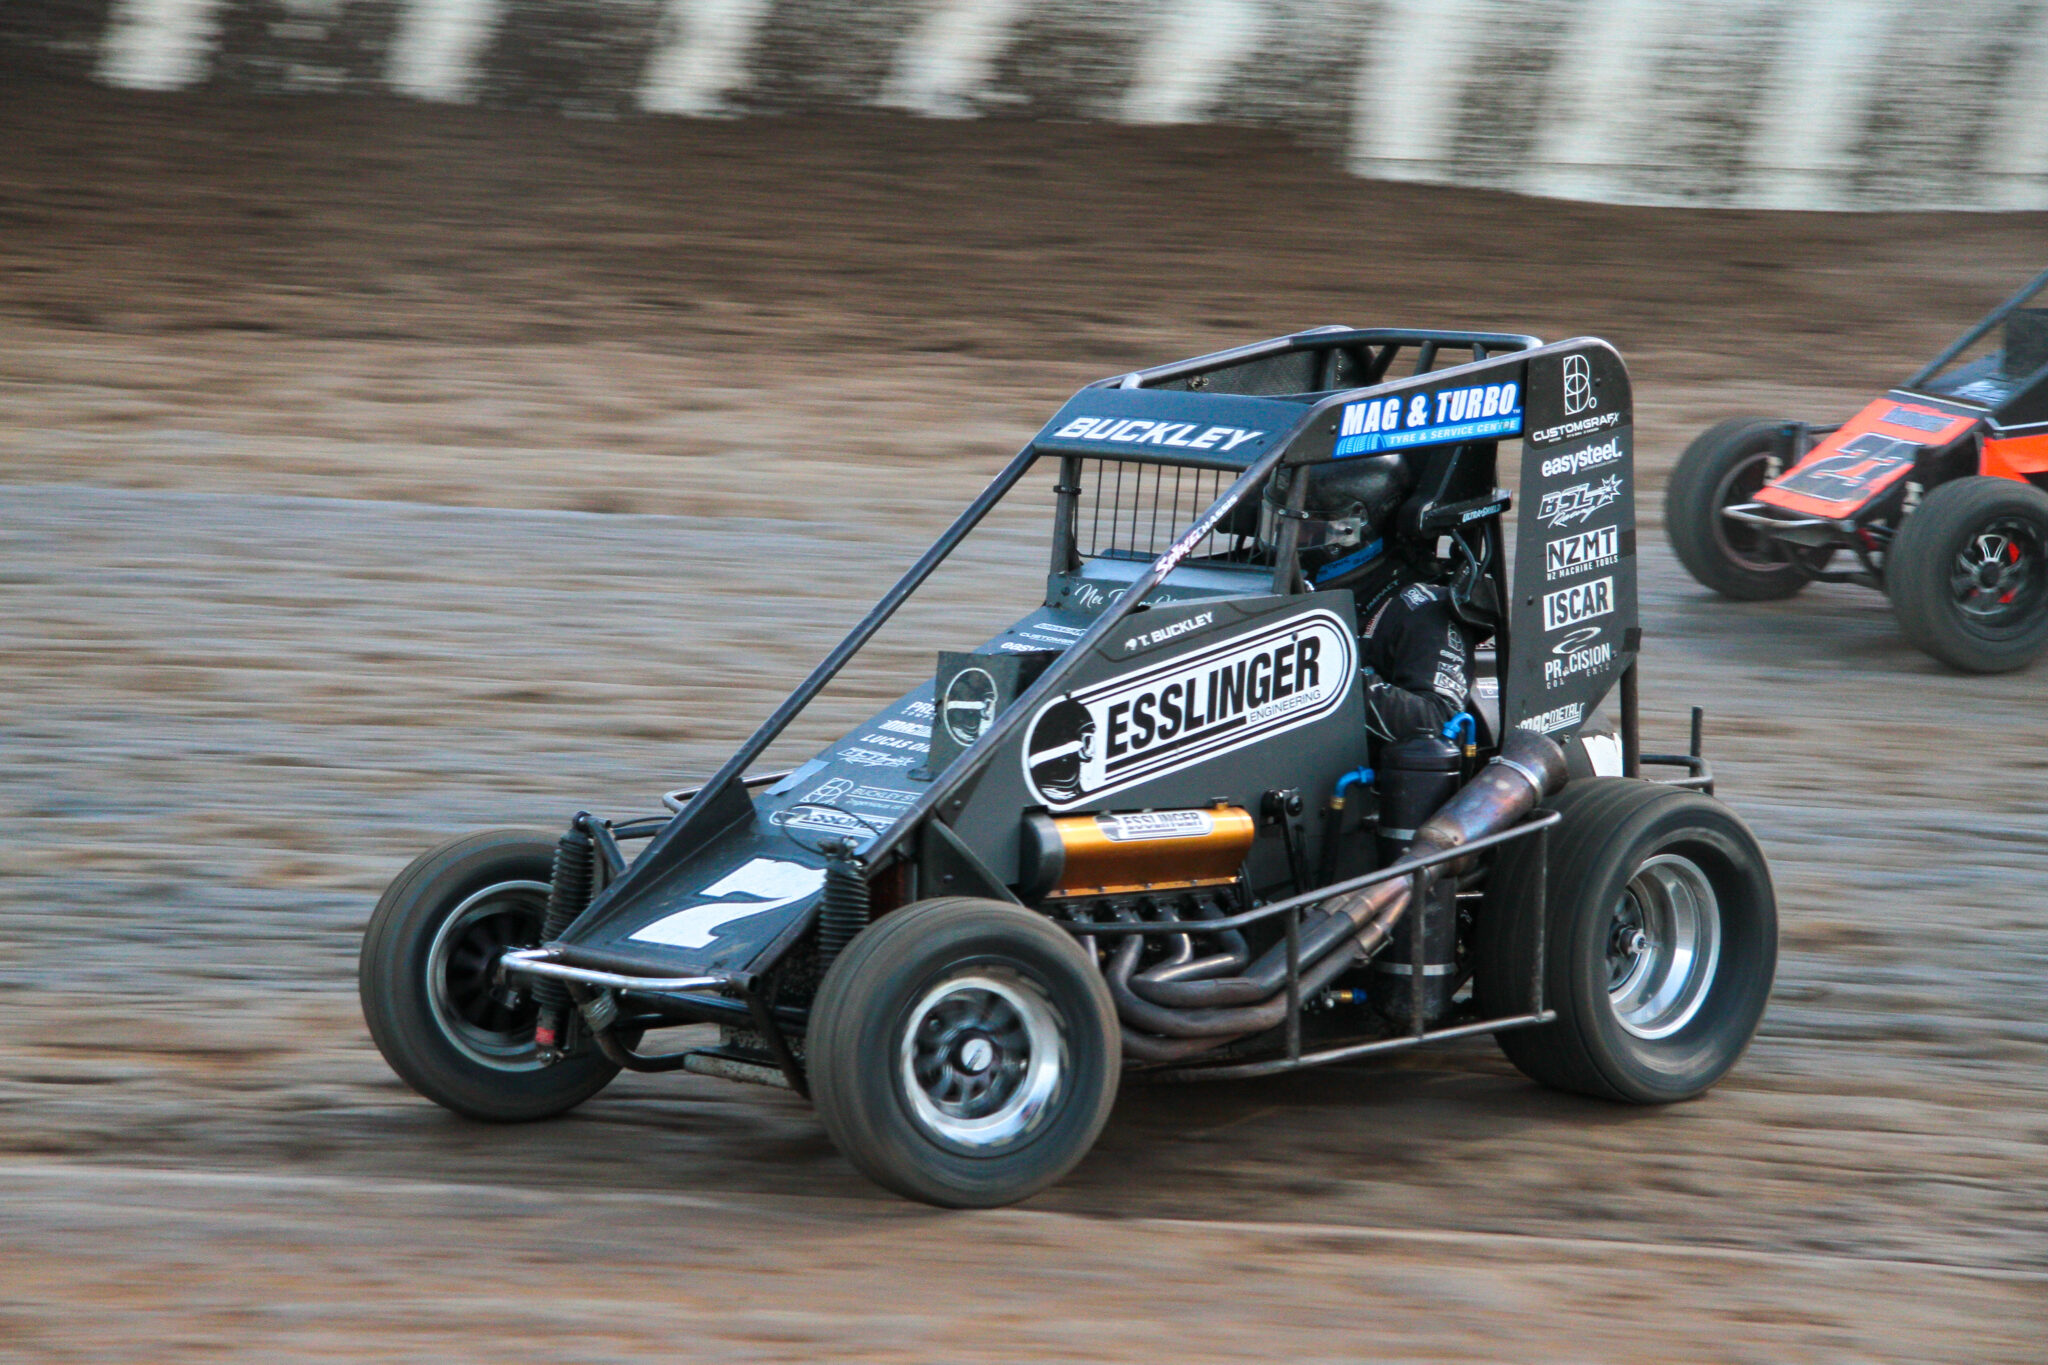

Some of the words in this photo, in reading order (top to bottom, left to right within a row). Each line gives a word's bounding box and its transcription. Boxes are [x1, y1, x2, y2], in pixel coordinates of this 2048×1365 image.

[1341, 398, 1400, 437] MAG
[1406, 395, 1428, 428] &
[1436, 384, 1517, 424] TURBO
[1532, 411, 1620, 442] CUSTOMGRAFX
[1053, 416, 1264, 451] BUCKLEY
[1390, 433, 1416, 445] TYRE
[1419, 432, 1426, 441] &
[1431, 426, 1473, 439] SERVICE
[1477, 420, 1516, 433] CENTRE
[1547, 526, 1617, 571] NZMT
[1547, 571, 1557, 581] NZ
[1559, 561, 1593, 578] MACHINE
[1595, 555, 1619, 568] TOOLS
[1549, 580, 1609, 627] ISCAR
[1138, 635, 1151, 647] T.
[1151, 612, 1214, 643] BUCKLEY
[1544, 642, 1611, 681] PRCISION
[1106, 636, 1322, 760] ESSLINGER
[1249, 689, 1322, 723] ENGINEERING
[860, 733, 914, 749] LUCAS
[628, 858, 827, 949] 7
